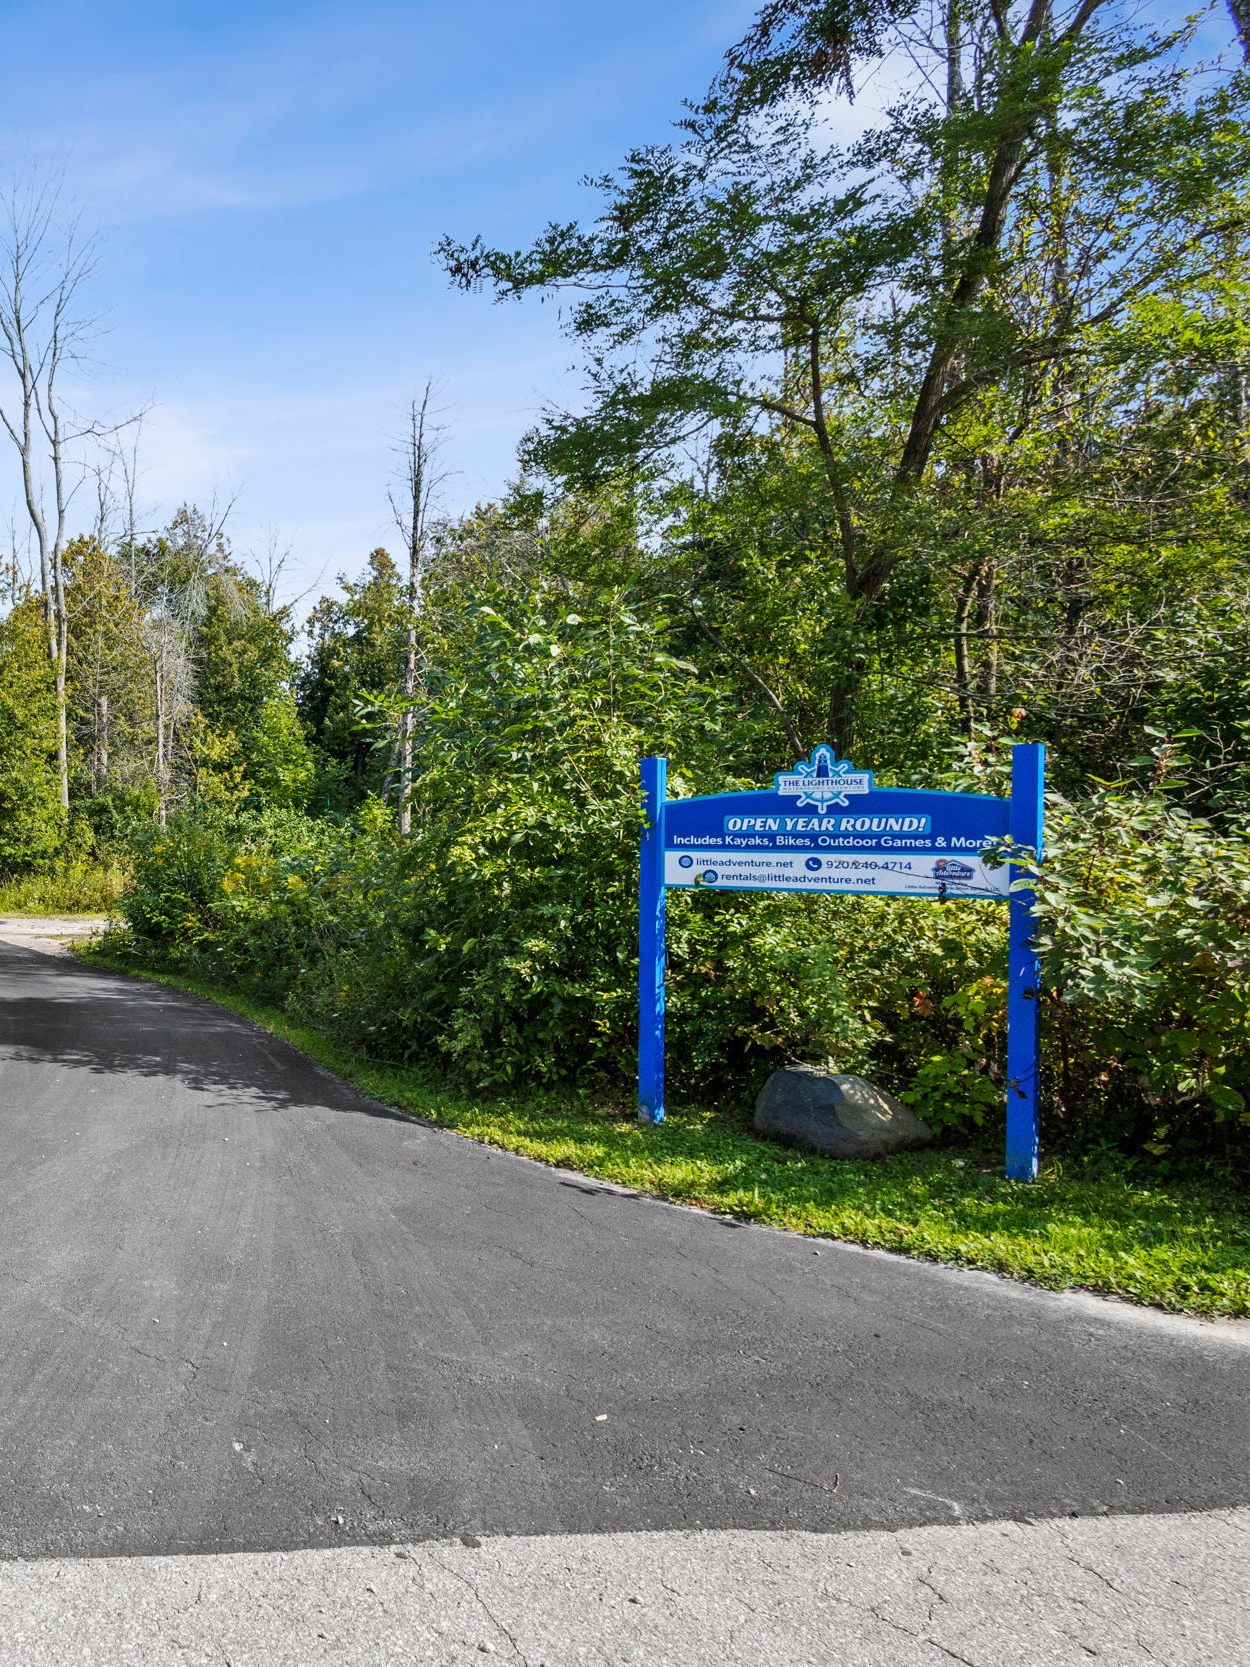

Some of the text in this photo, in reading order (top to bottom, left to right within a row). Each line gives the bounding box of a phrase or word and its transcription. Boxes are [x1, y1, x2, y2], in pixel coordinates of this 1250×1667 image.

[802, 778, 865, 786] LIGHTHOUSE
[728, 817, 927, 832] OPEN YEAR ROUND!
[673, 835, 723, 845] Includes
[725, 835, 773, 847] Kayaks,
[776, 835, 815, 847] Bikes,
[818, 836, 878, 847] Outdoor
[880, 836, 932, 848] Games
[935, 836, 947, 848] &
[696, 858, 794, 868] littleadventure.net
[825, 860, 912, 871] 920.240.4714
[721, 873, 876, 885] rentals@littleadventure.net
